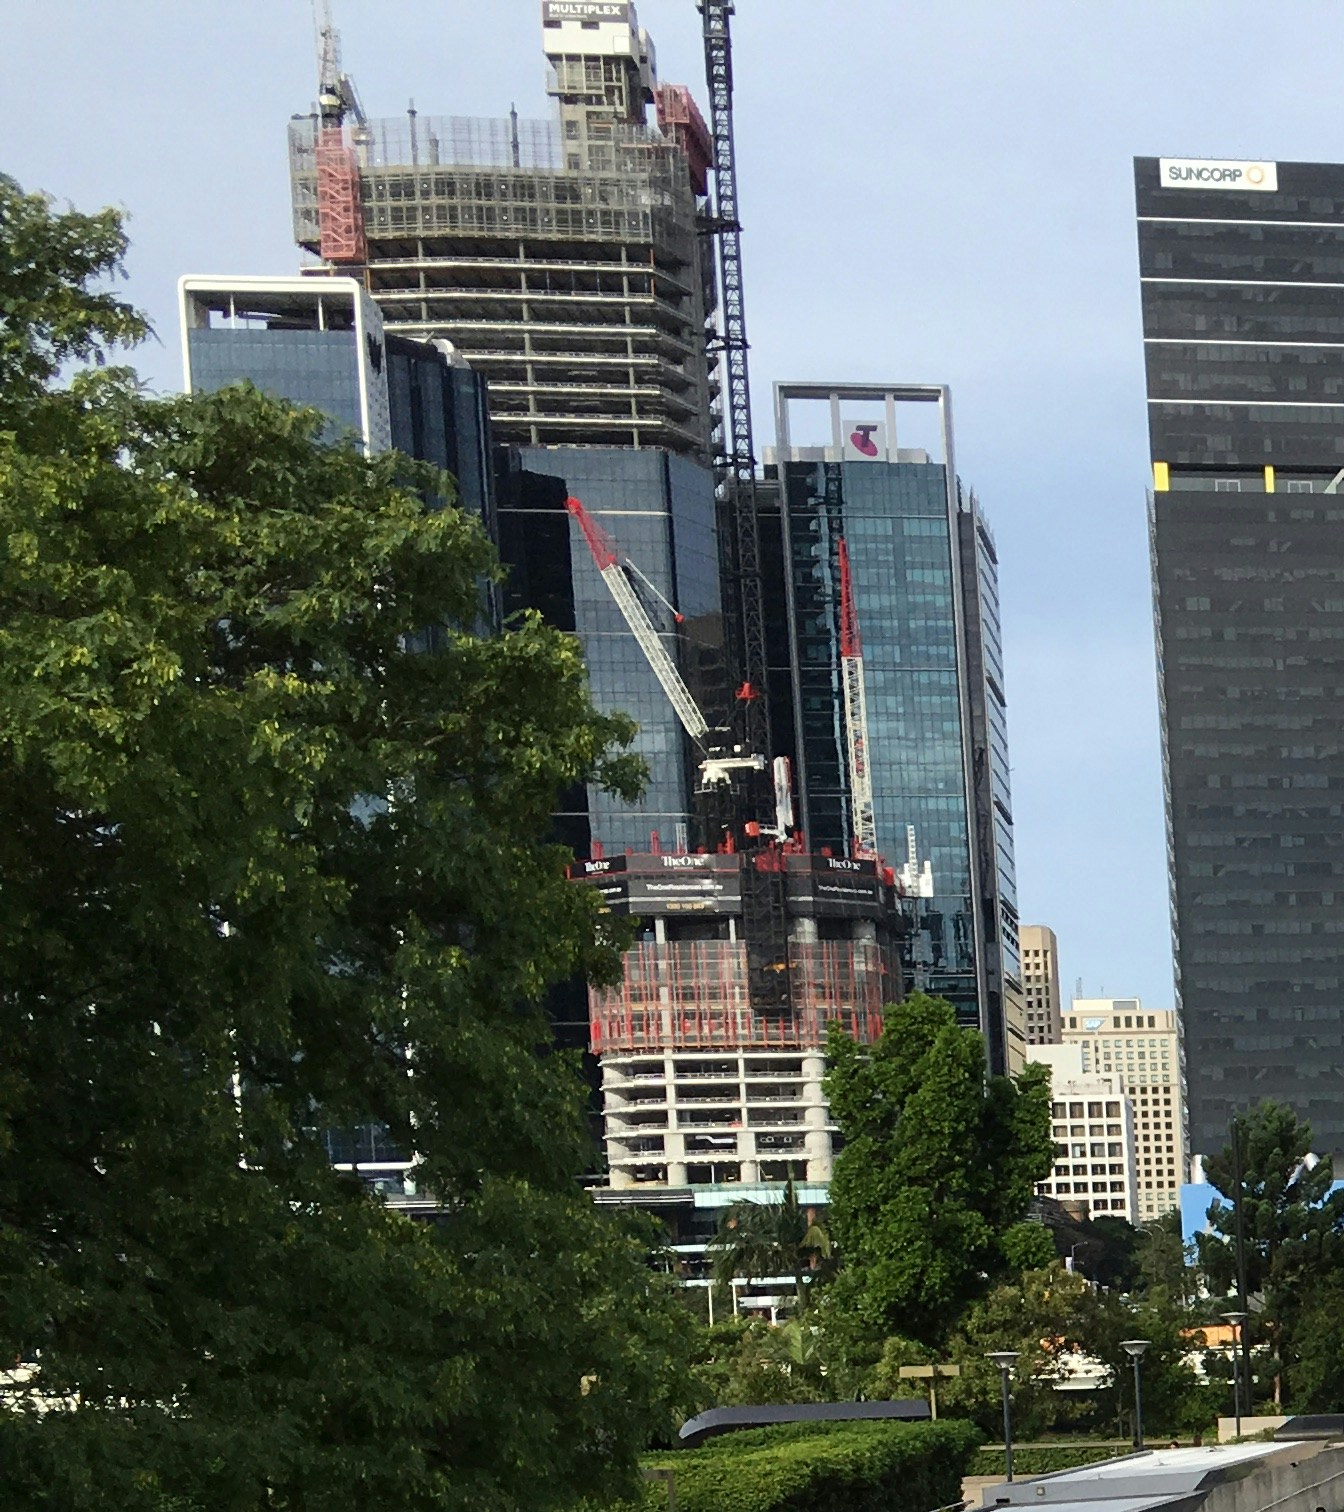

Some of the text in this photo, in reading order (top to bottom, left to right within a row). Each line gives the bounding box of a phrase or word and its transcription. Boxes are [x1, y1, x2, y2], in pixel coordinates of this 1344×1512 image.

[548, 3, 622, 15] MULTIPLEX
[1168, 166, 1243, 182] SUNCORP
[661, 856, 705, 867] TheOne
